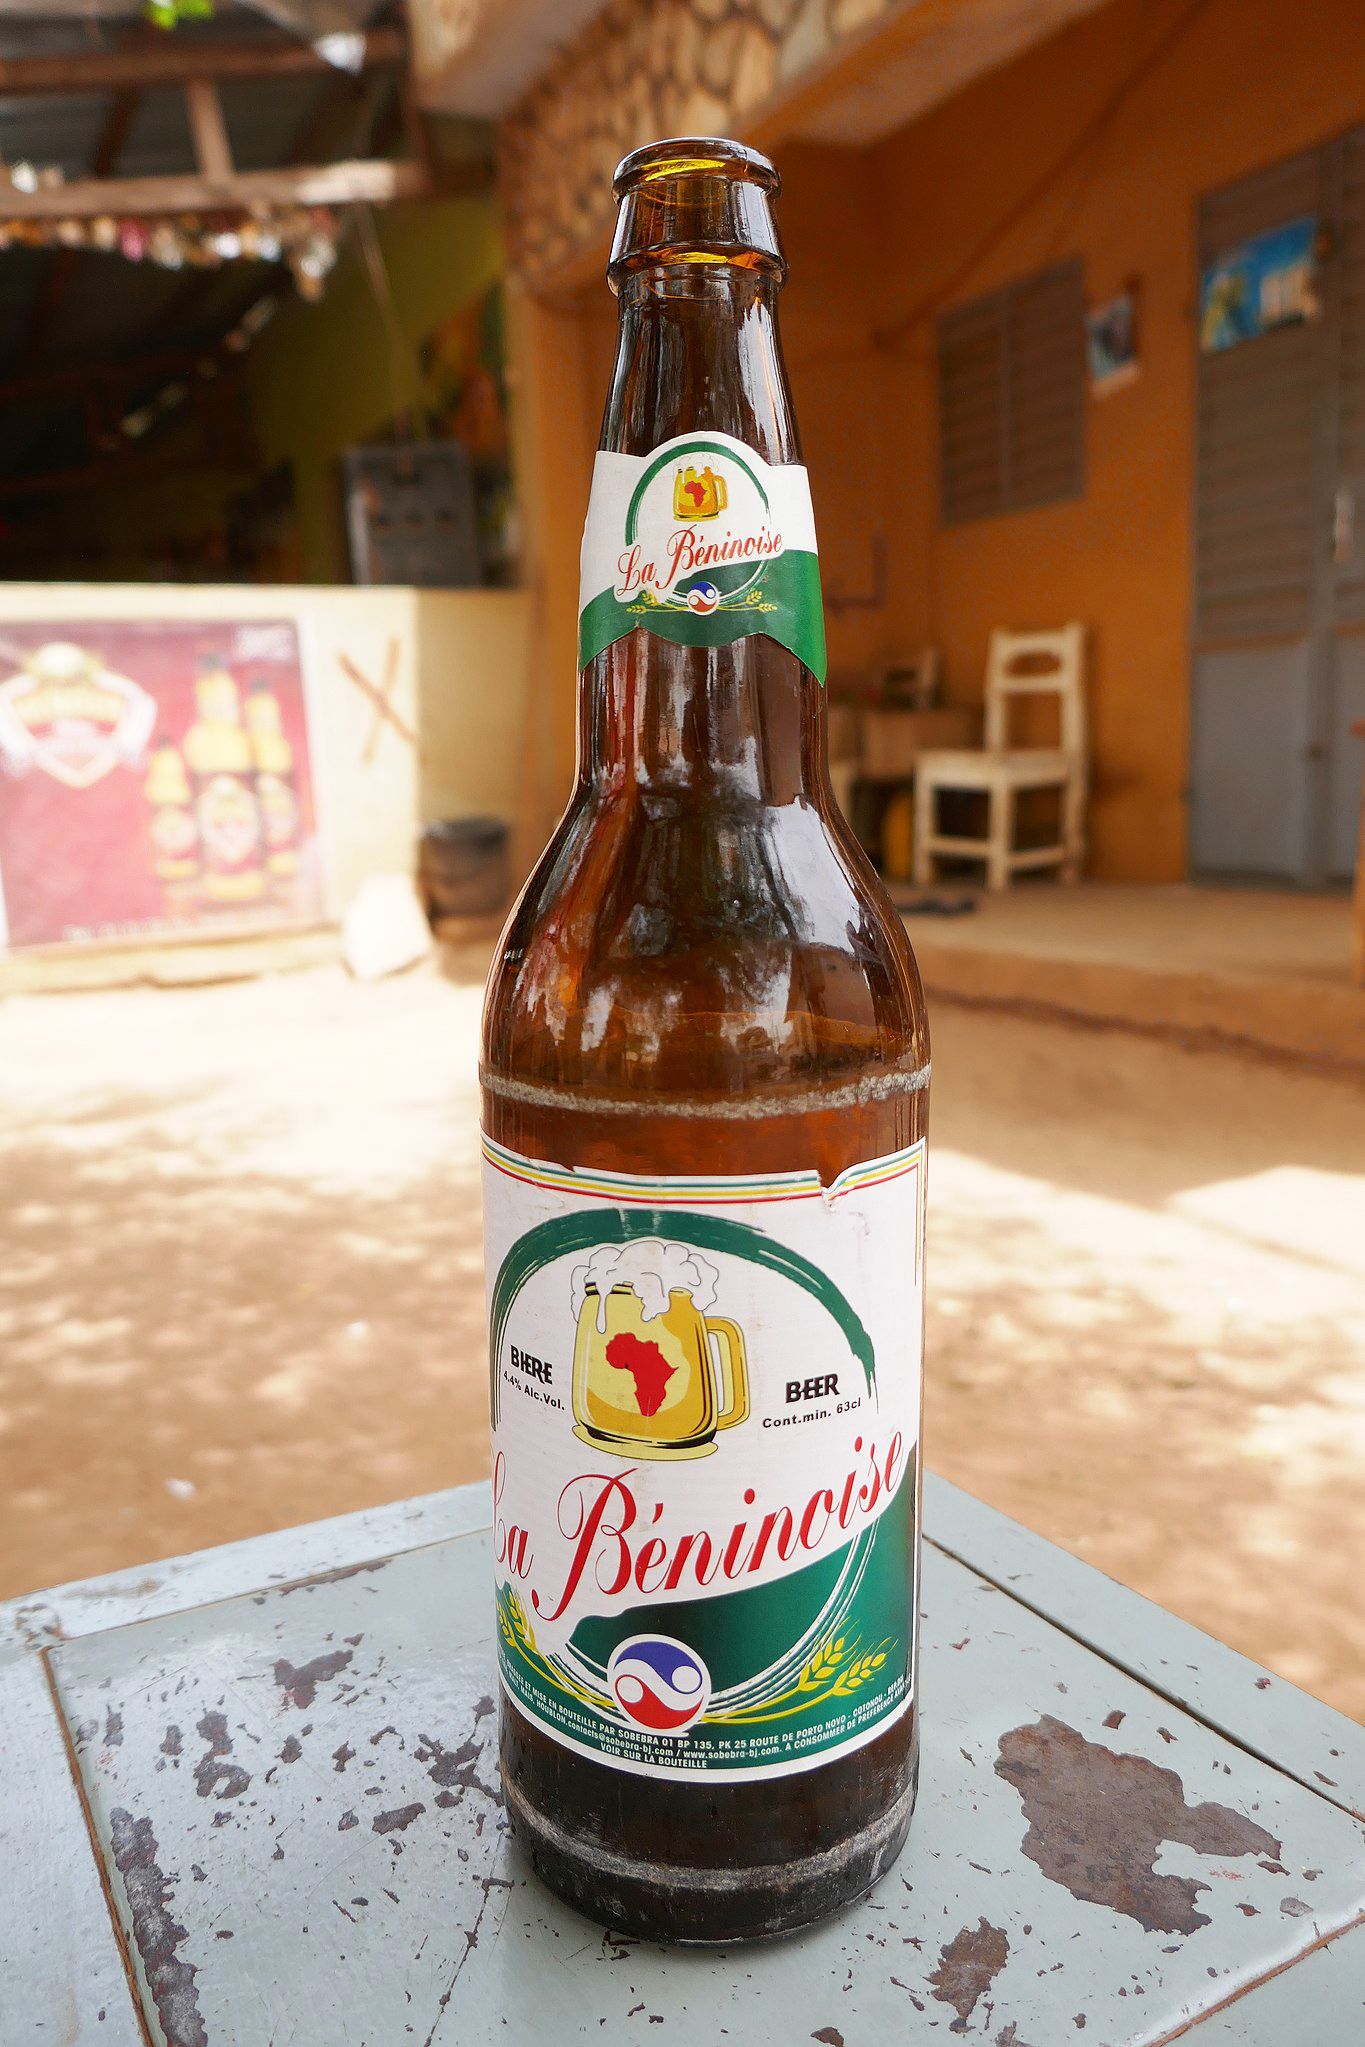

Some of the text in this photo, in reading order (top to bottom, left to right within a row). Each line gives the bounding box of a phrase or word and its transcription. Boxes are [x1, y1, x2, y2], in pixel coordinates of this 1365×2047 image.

[616, 523, 783, 597] La Béninoise
[510, 1344, 553, 1385] BIERE
[503, 1370, 565, 1411] 4.4% Alc.Vol.
[785, 1373, 841, 1404] BEER
[762, 1397, 861, 1429] Cont.min. 63cl
[531, 1431, 902, 1622] Béninoise
[532, 1686, 547, 1704] MISE
[548, 1698, 557, 1711] EN
[558, 1704, 597, 1728] BOUTEILLE
[599, 1722, 616, 1736] PAR
[618, 1729, 659, 1745] SOBEBRA
[661, 1737, 673, 1747] 01
[677, 1740, 690, 1749] BP
[718, 1740, 731, 1750] PK
[734, 1739, 747, 1749] 25
[749, 1735, 779, 1748] ROUTE
[782, 1731, 794, 1742] DE
[796, 1723, 823, 1739] PORTO
[825, 1714, 846, 1730] NOVO
[852, 1693, 883, 1717] COTONOU
[785, 1742, 792, 1751] A
[794, 1724, 845, 1749] CONSOMMER
[846, 1719, 856, 1730] DE
[857, 1693, 894, 1724] PREFERENCE
[600, 1742, 707, 1769] VOIR SUR LA BOUTEILLE
